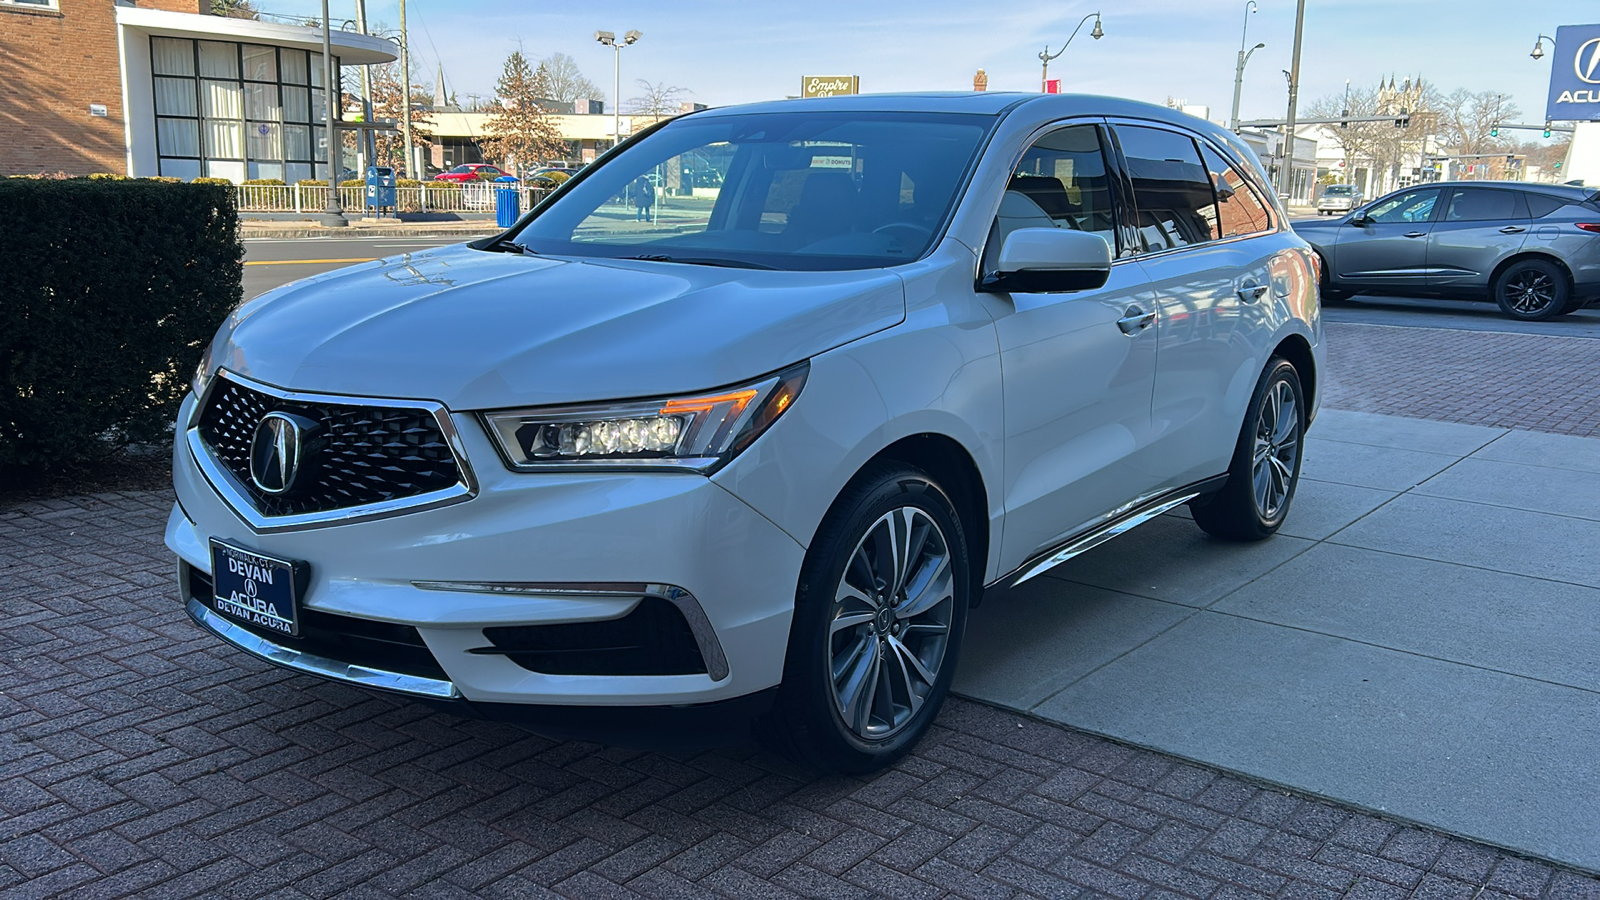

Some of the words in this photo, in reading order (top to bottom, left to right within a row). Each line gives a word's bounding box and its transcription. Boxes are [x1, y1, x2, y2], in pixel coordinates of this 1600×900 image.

[808, 78, 849, 93] Empire
[228, 557, 273, 585] DEVAN
[217, 600, 250, 620] DEVAN
[253, 614, 292, 633] ACURA
[230, 590, 279, 618] ACURA
